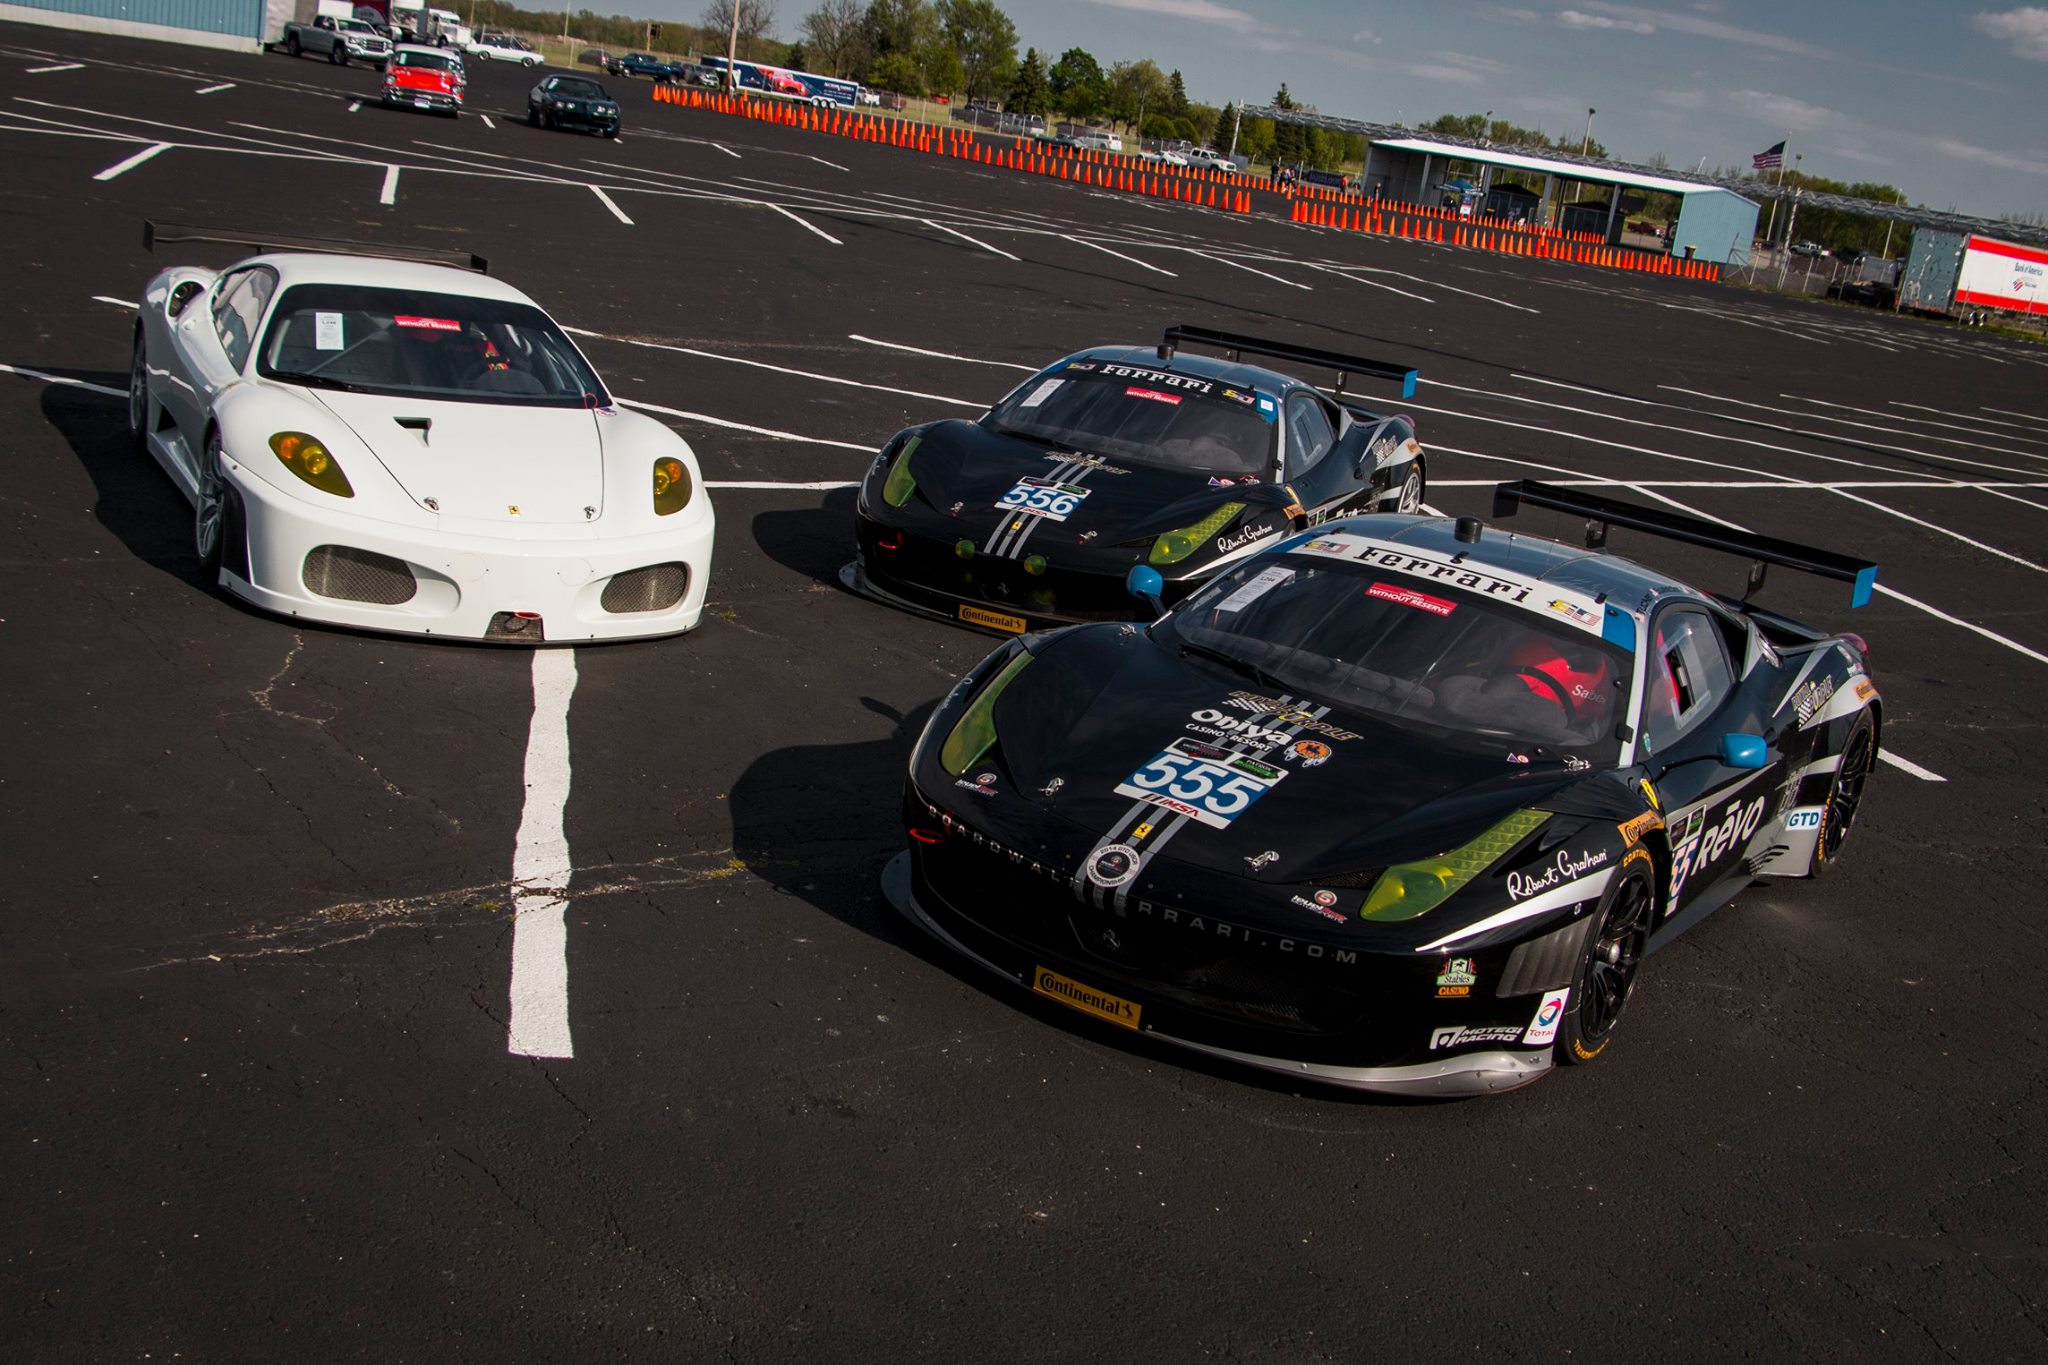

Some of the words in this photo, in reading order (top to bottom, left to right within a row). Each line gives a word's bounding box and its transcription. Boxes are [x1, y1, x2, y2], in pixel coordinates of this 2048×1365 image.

[1100, 364, 1213, 393] Ferrari
[1003, 485, 1079, 515] 556
[1217, 534, 1247, 553] Robert
[1244, 523, 1273, 541] Graham
[1353, 546, 1534, 603] Ferrari
[1369, 588, 1411, 603] WITHOUT
[1410, 599, 1451, 615] RESERVE
[962, 607, 1014, 628] Continental
[1185, 723, 1225, 738] CASINO
[1228, 733, 1273, 752] RESORT
[1133, 754, 1265, 814] 555
[1158, 799, 1200, 817] IMSA
[1789, 812, 1820, 827] GTD
[1100, 846, 1117, 854] 2014
[1089, 865, 1126, 885] CHAMPIONSHIP
[1507, 867, 1559, 900] Robert
[1556, 850, 1607, 880] Graham
[1444, 973, 1471, 984] Stables
[1040, 973, 1120, 1015] Continental
[1438, 986, 1470, 996] CASINO
[1455, 1033, 1518, 1045] RACING
[1462, 1026, 1524, 1036] MOTEGI
